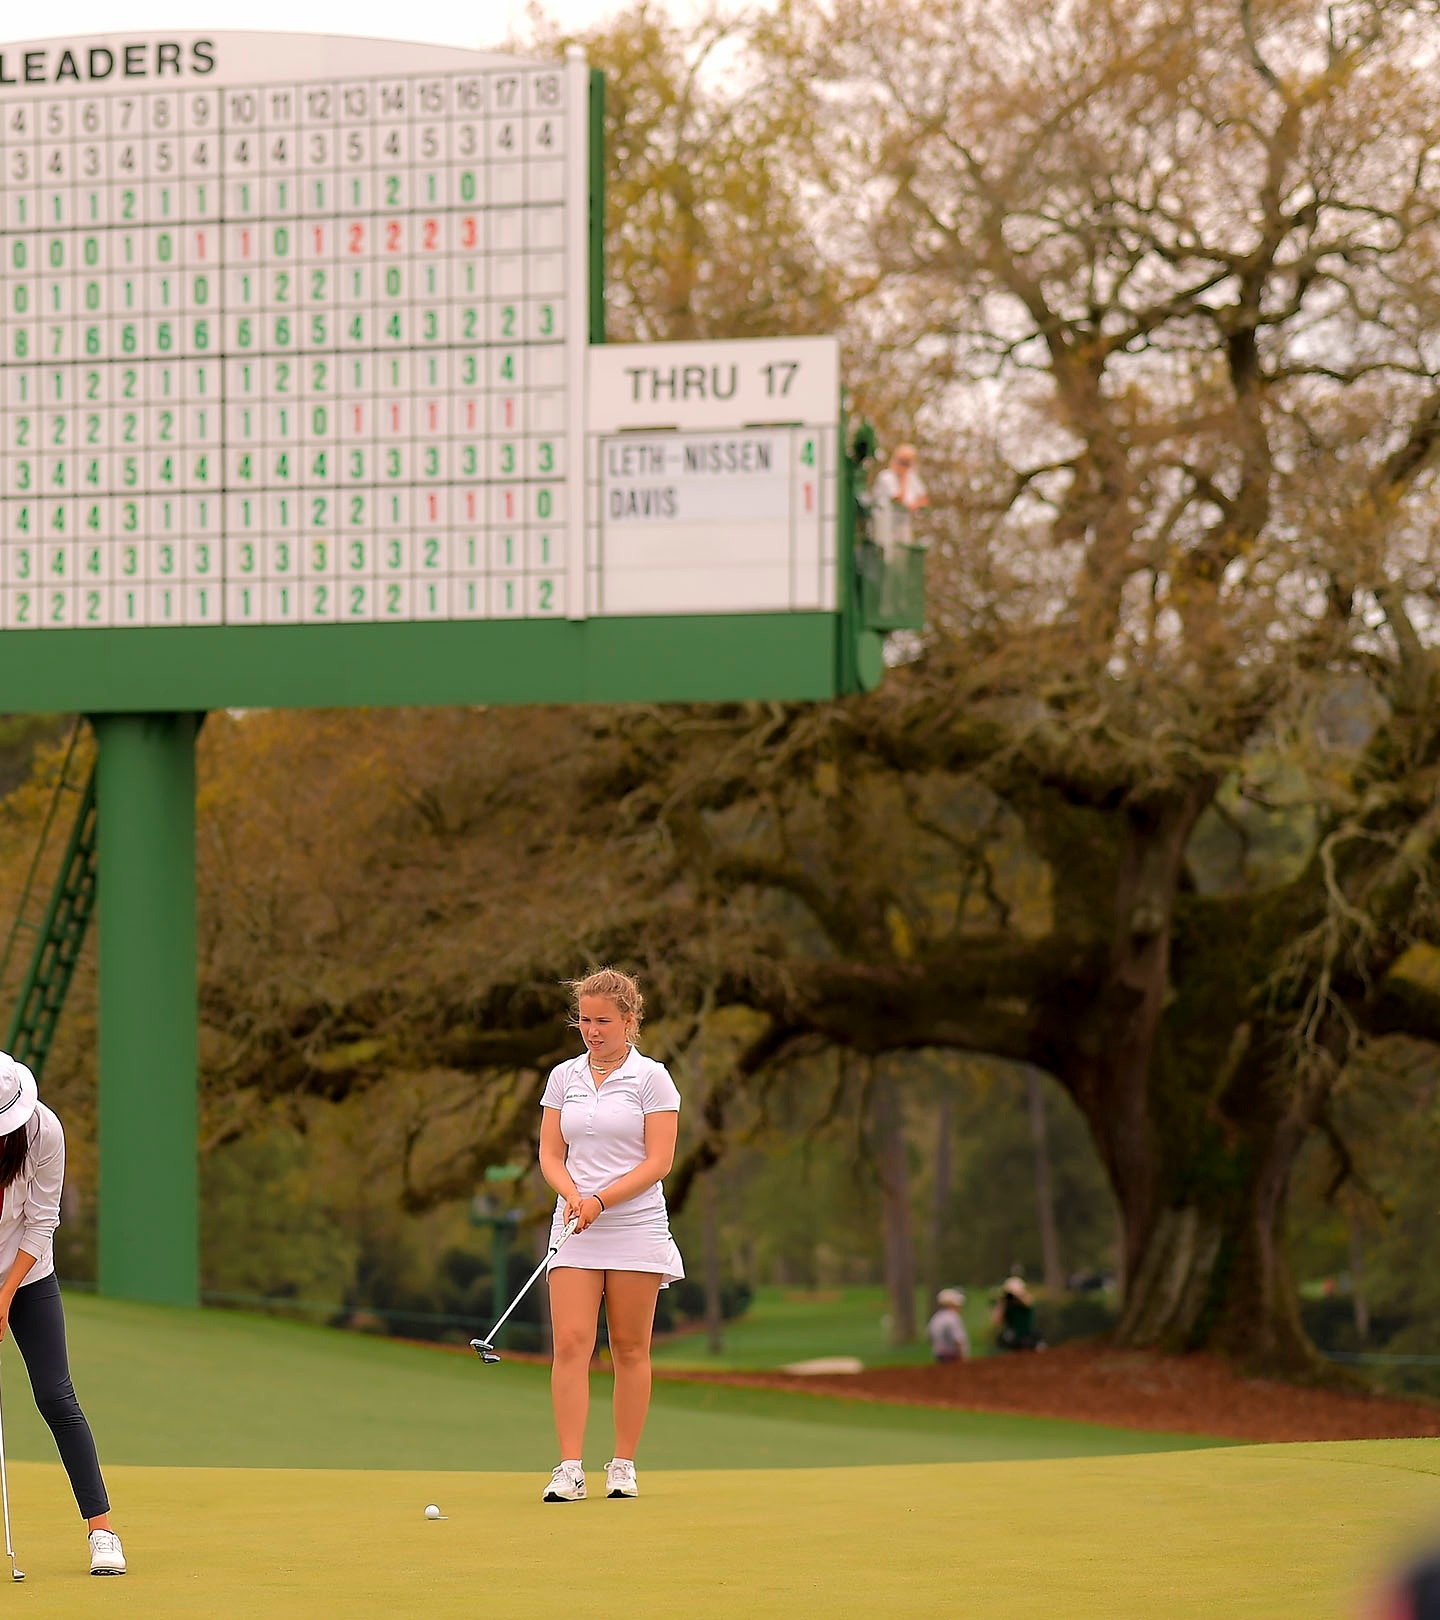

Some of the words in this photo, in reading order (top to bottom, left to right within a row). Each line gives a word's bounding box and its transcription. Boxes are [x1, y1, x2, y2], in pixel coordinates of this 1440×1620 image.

[11, 108, 25, 137] 4
[48, 105, 62, 134] 5
[84, 103, 98, 132] 6
[121, 101, 135, 130] 7
[158, 99, 172, 128] 8
[195, 97, 209, 126] 9
[229, 94, 253, 123] 10
[267, 92, 291, 121] 11
[305, 90, 329, 119] 12
[343, 88, 367, 117] 13
[381, 85, 405, 114] 14
[419, 83, 443, 112] 15
[457, 81, 481, 110] 16
[494, 78, 518, 107] 17
[532, 76, 556, 105] 18
[13, 152, 27, 181] 3
[47, 150, 61, 179] 4
[85, 148, 99, 177] 3
[121, 146, 135, 175] 4
[159, 144, 173, 173] 5
[195, 142, 209, 171] 4
[233, 139, 247, 168] 4
[271, 137, 285, 166] 4
[310, 135, 324, 164] 3
[348, 133, 362, 162] 5
[385, 131, 399, 160] 4
[424, 129, 438, 158] 5
[462, 126, 476, 155] 3
[499, 124, 513, 153] 4
[536, 122, 550, 151] 4
[122, 190, 134, 220] 2
[388, 176, 400, 206] 2
[462, 172, 476, 202] 0
[14, 240, 26, 268] 0
[50, 240, 64, 268] 0
[84, 238, 98, 266] 0
[158, 234, 172, 262] 0
[274, 228, 288, 256] 0
[350, 224, 364, 254] 2
[388, 222, 400, 252] 2
[424, 220, 438, 250] 2
[464, 218, 476, 248] 3
[14, 284, 28, 314] 0
[86, 282, 100, 310] 0
[194, 276, 208, 304] 0
[276, 272, 288, 302] 2
[312, 270, 326, 300] 2
[386, 268, 400, 296] 0
[16, 330, 28, 358] 8
[50, 327, 64, 356] 7
[86, 326, 100, 356] 6
[276, 316, 290, 346] 6
[312, 316, 326, 344] 5
[350, 314, 362, 342] 4
[386, 312, 402, 340] 4
[424, 312, 438, 340] 3
[464, 308, 476, 338] 2
[502, 306, 516, 336] 2
[542, 306, 554, 336] 3
[88, 372, 100, 400] 2
[124, 370, 136, 398] 2
[276, 362, 290, 392] 2
[314, 362, 326, 392] 2
[464, 356, 476, 384] 3
[501, 353, 515, 382] 4
[625, 364, 738, 402] THRU
[760, 360, 801, 398] 17
[160, 412, 172, 440] 2
[314, 406, 326, 436] 0
[18, 460, 30, 490] 3
[51, 460, 65, 489] 4
[87, 459, 101, 488] 4
[126, 458, 138, 486] 5
[161, 456, 175, 485] 4
[312, 452, 328, 478] 4
[352, 450, 364, 480] 3
[464, 446, 476, 476] 3
[502, 444, 514, 474] 3
[540, 442, 554, 472] 3
[608, 441, 774, 477] LETH-NISSEN
[800, 439, 815, 468] 4
[15, 505, 29, 534] 4
[88, 503, 102, 532] 4
[124, 502, 138, 532] 3
[312, 496, 328, 526] 2
[352, 496, 364, 524] 2
[538, 490, 552, 518] 0
[610, 485, 679, 521] DAVIS
[18, 550, 30, 578] 3
[52, 548, 66, 577] 4
[88, 547, 102, 576] 4
[124, 548, 138, 576] 3
[352, 540, 366, 570] 3
[388, 540, 402, 570] 3
[424, 538, 440, 568] 2
[16, 593, 30, 622] 2
[52, 593, 66, 622] 2
[540, 580, 554, 610] 2
